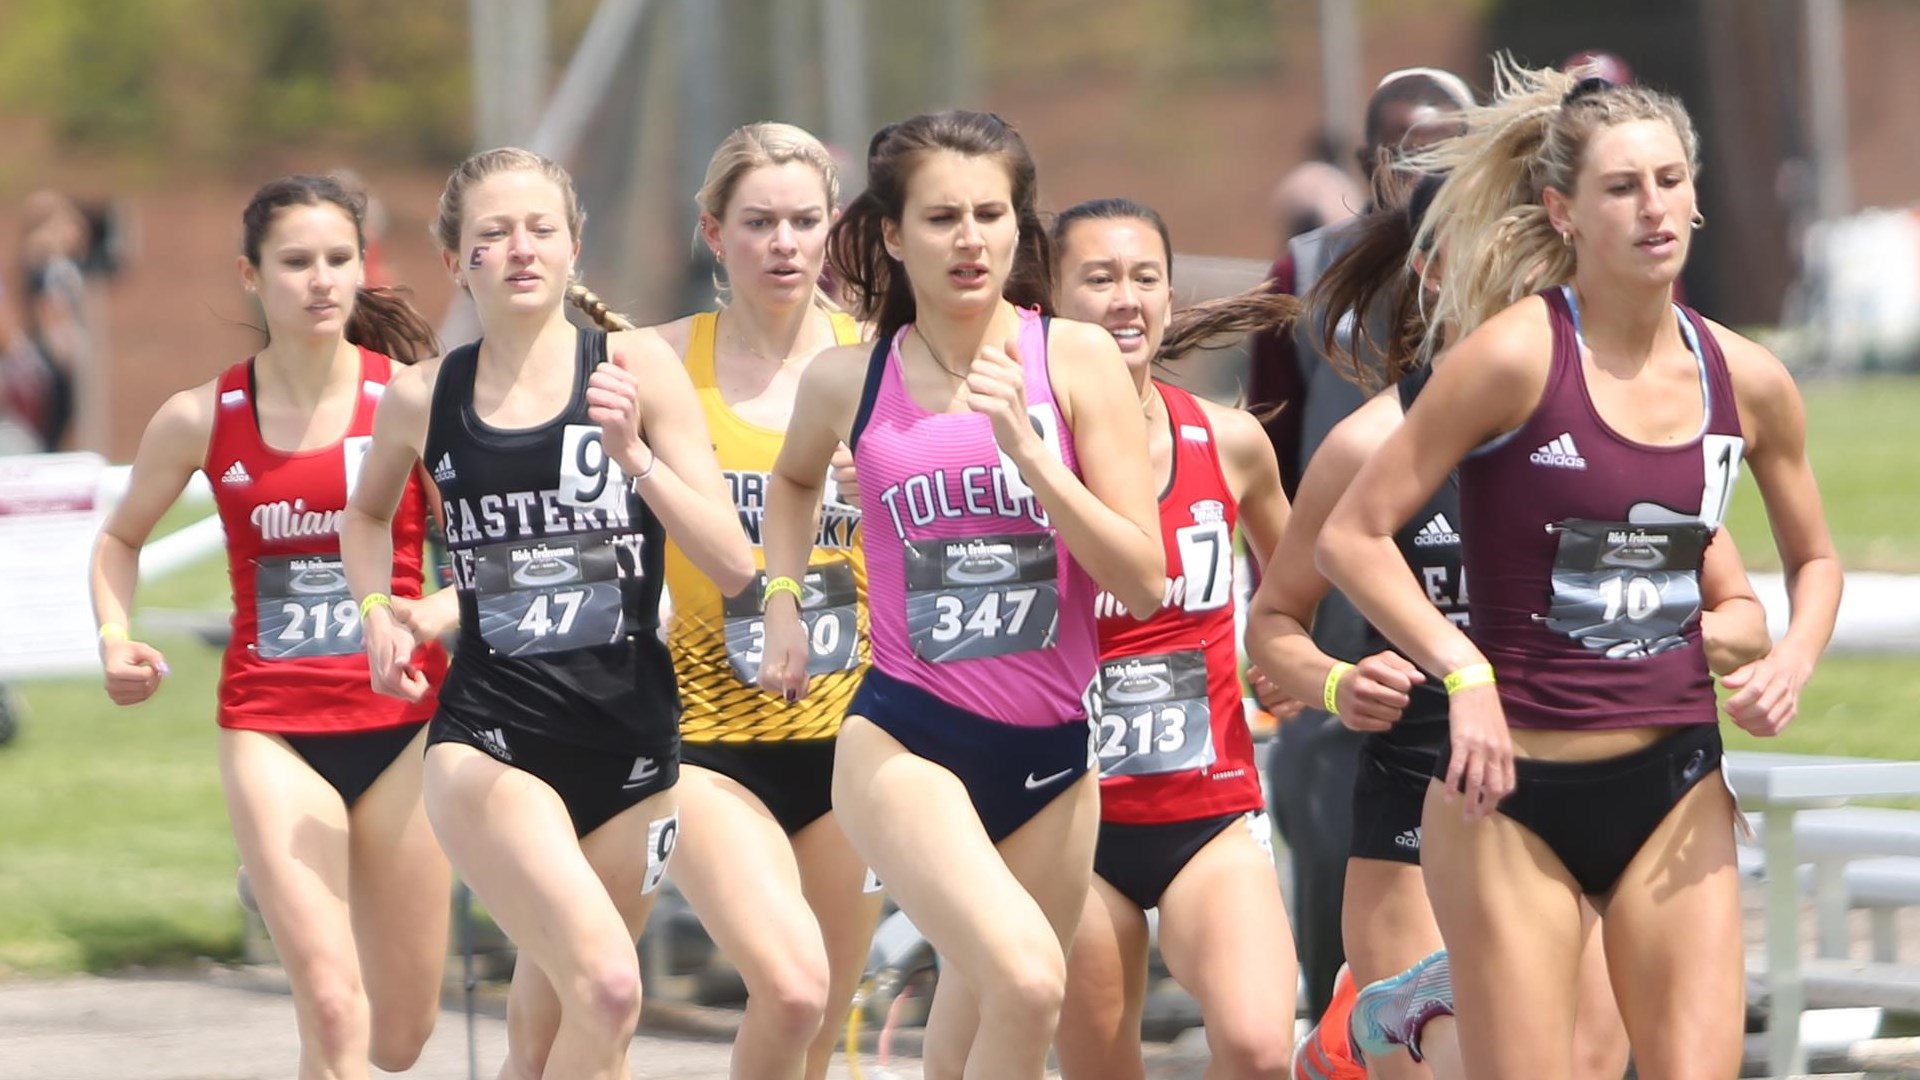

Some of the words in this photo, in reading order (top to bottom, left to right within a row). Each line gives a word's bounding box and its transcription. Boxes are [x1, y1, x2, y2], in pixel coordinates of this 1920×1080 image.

[574, 430, 609, 503] 9
[1529, 450, 1587, 471] adidas
[1717, 443, 1731, 521] 1
[1414, 532, 1461, 546] adidas
[1607, 531, 1627, 543] Rick
[1191, 530, 1219, 603] 7
[277, 600, 360, 641] 219
[516, 590, 586, 636] 47
[931, 588, 1038, 642] 347
[1599, 576, 1662, 621] 10
[746, 613, 840, 663] 30
[1098, 707, 1187, 758] 213
